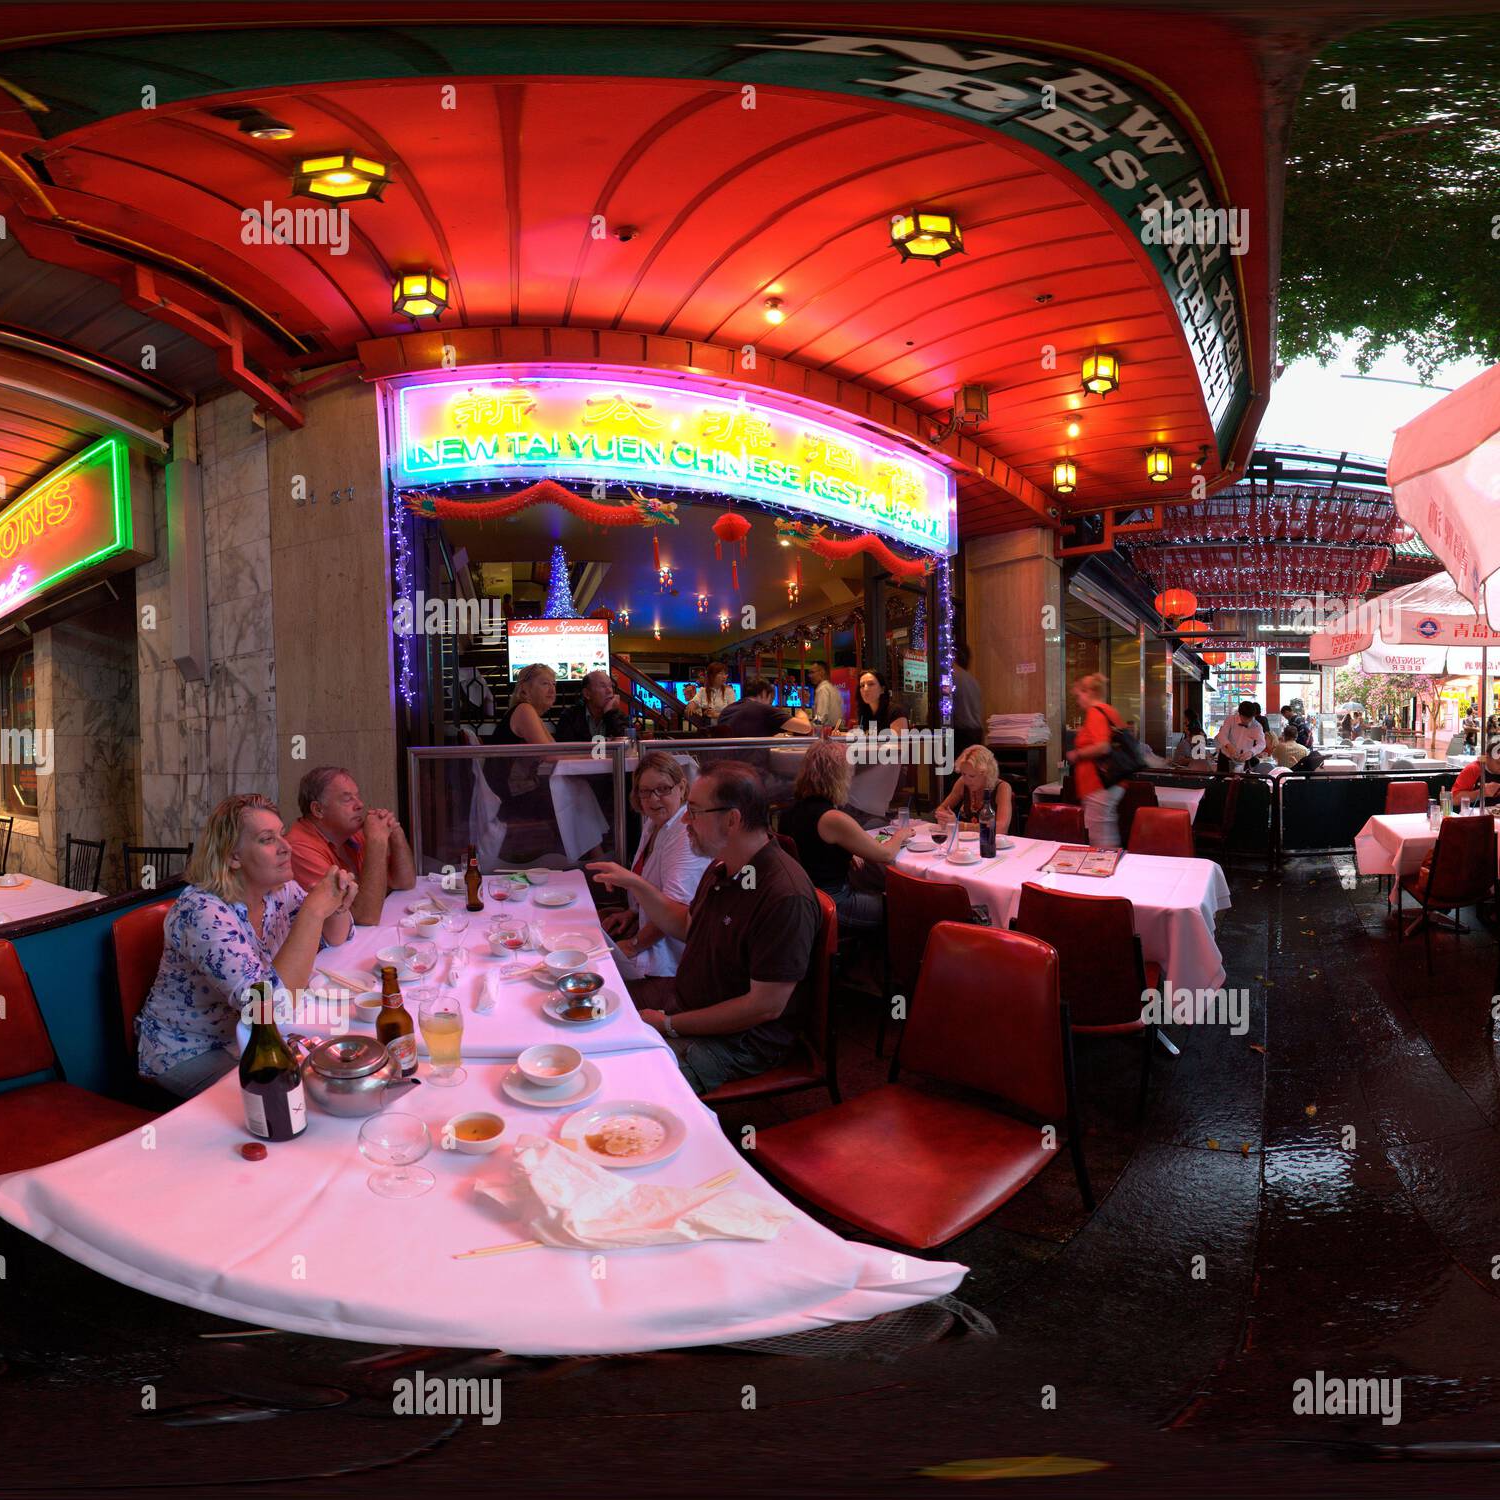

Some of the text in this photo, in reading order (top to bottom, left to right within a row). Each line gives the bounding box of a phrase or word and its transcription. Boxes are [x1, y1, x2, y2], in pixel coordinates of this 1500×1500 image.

[735, 33, 1185, 155] NEW
[1213, 275, 1243, 386] YUEN
[412, 434, 499, 464] NEW
[505, 431, 560, 458] TAI
[568, 432, 665, 466] YUEN
[669, 442, 801, 490] CHINESE
[511, 620, 604, 635] House Specials
